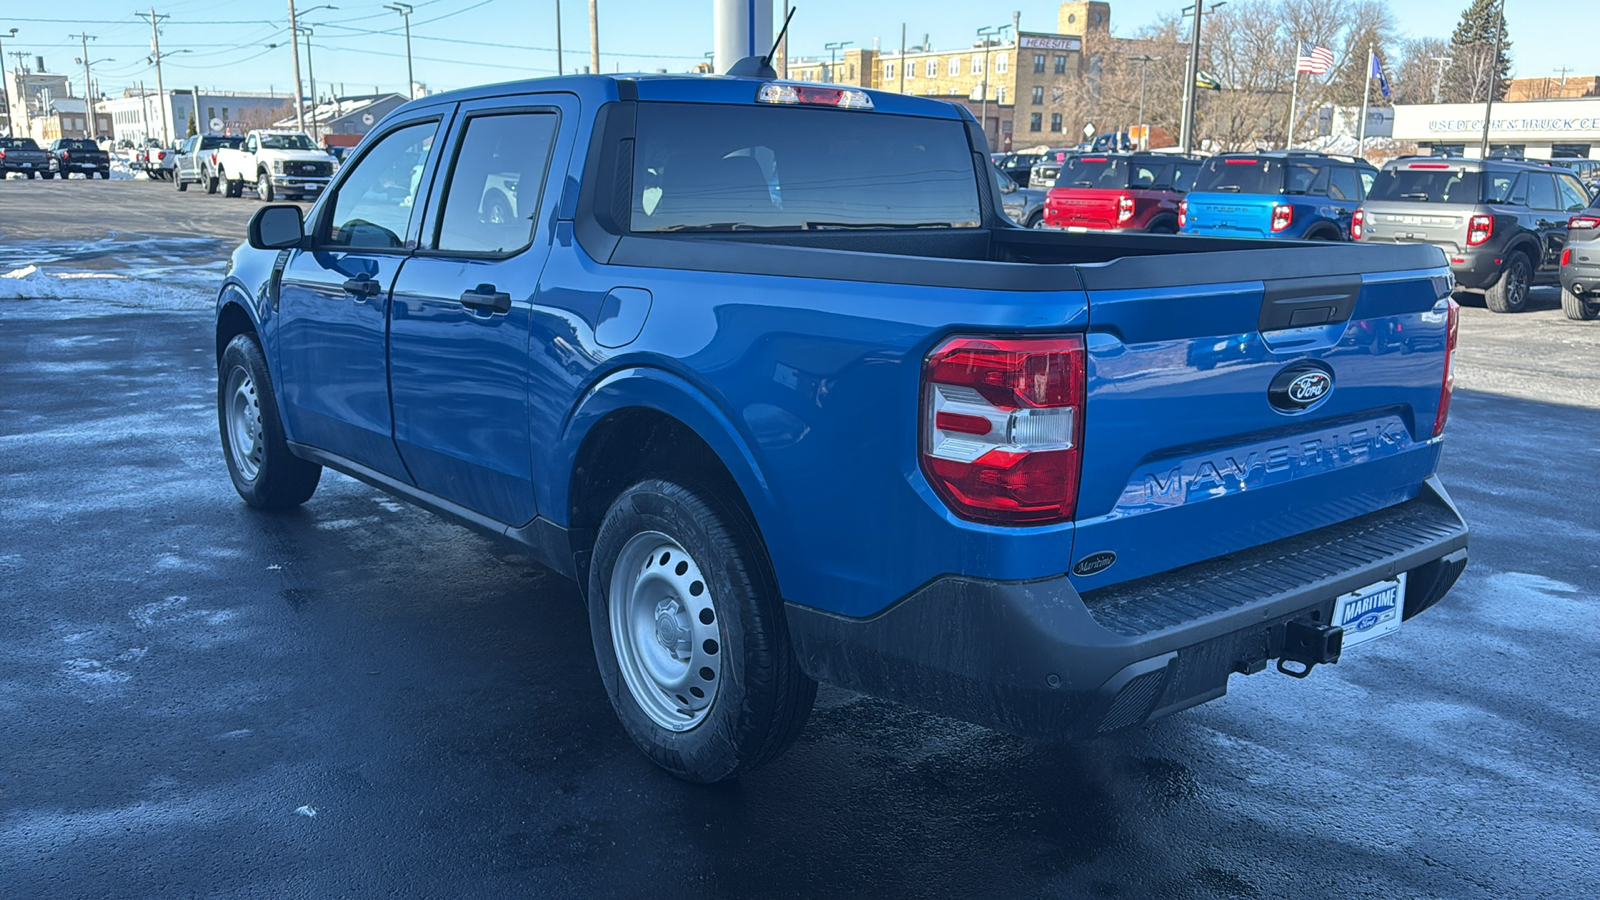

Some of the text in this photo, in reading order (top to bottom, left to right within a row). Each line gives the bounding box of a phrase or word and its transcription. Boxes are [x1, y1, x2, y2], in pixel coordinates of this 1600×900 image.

[1026, 39, 1071, 48] HERESITE
[1428, 119, 1466, 131] USED
[1521, 118, 1573, 130] TRUCK
[1296, 377, 1325, 399] Ford
[1143, 421, 1396, 500] MAVERICK
[1343, 588, 1396, 624] MARITIME
